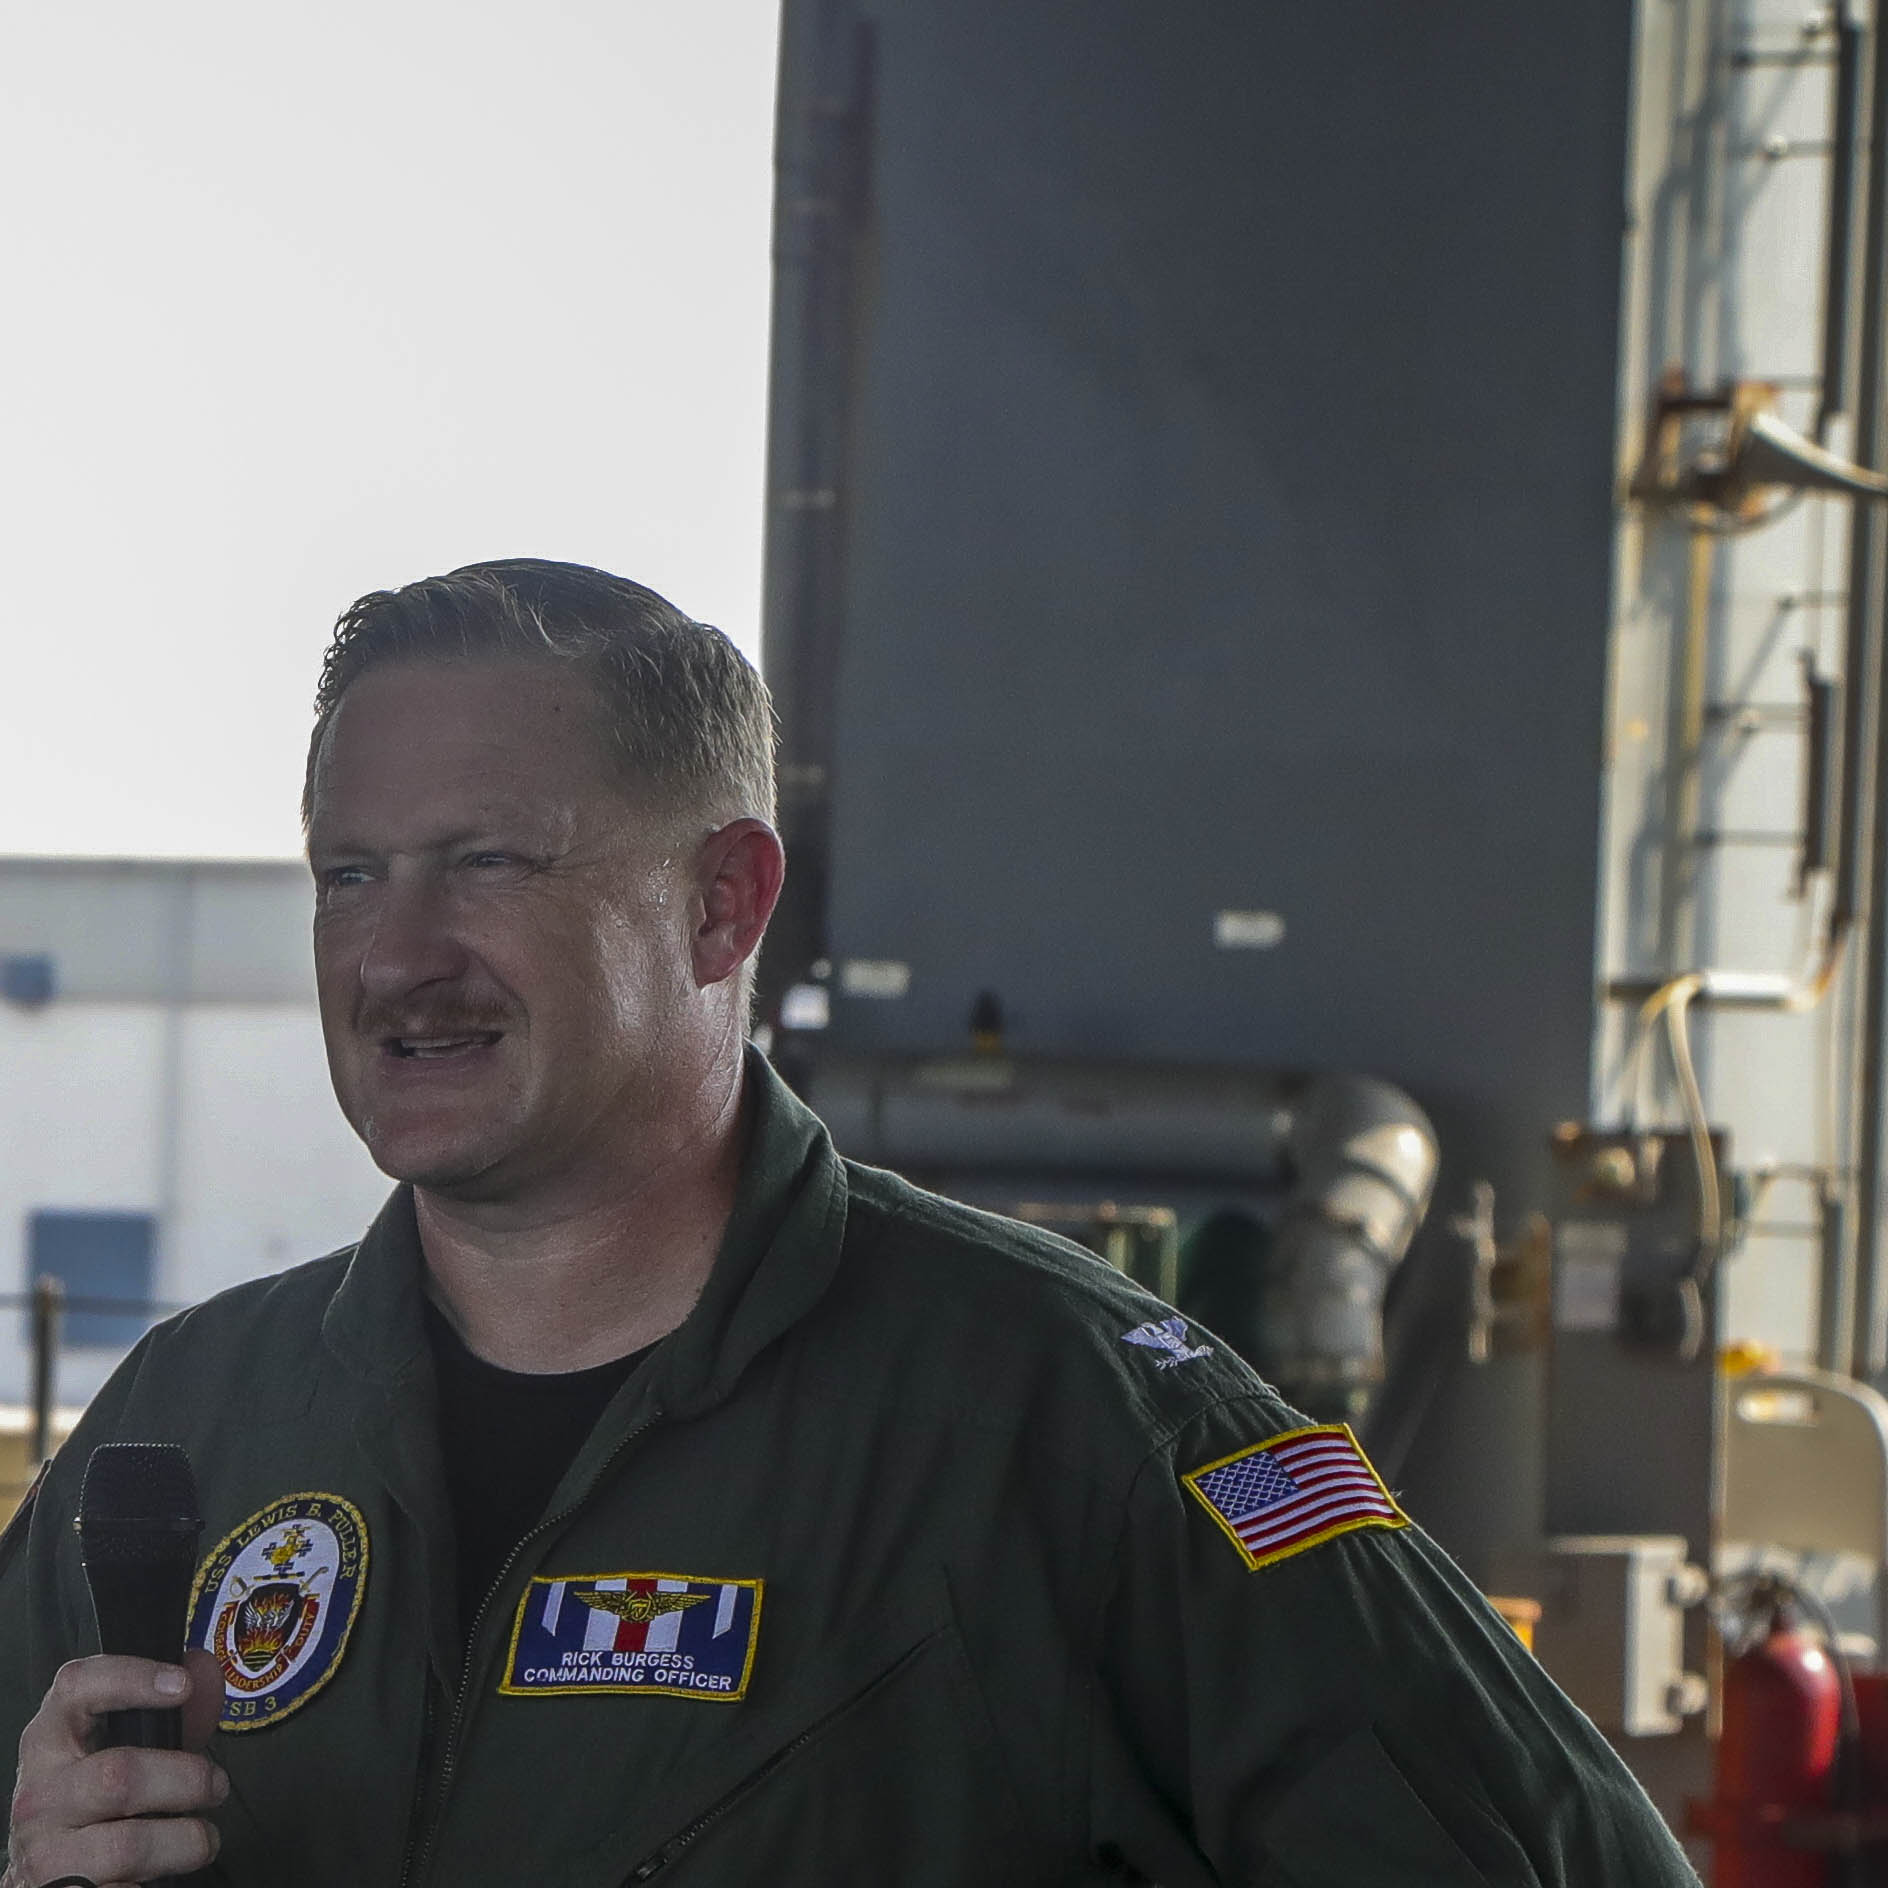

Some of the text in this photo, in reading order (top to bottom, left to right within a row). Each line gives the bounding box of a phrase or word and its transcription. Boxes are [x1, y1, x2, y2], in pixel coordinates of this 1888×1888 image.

[205, 1555, 231, 1593] USS
[236, 1504, 298, 1548] LEWIS
[328, 1509, 358, 1580] PULLER
[295, 1612, 315, 1647] DUTY
[561, 1651, 695, 1670] RICK BURGESS
[523, 1667, 732, 1690] COMMANDING OFFICER
[223, 1696, 277, 1717] SB 3
